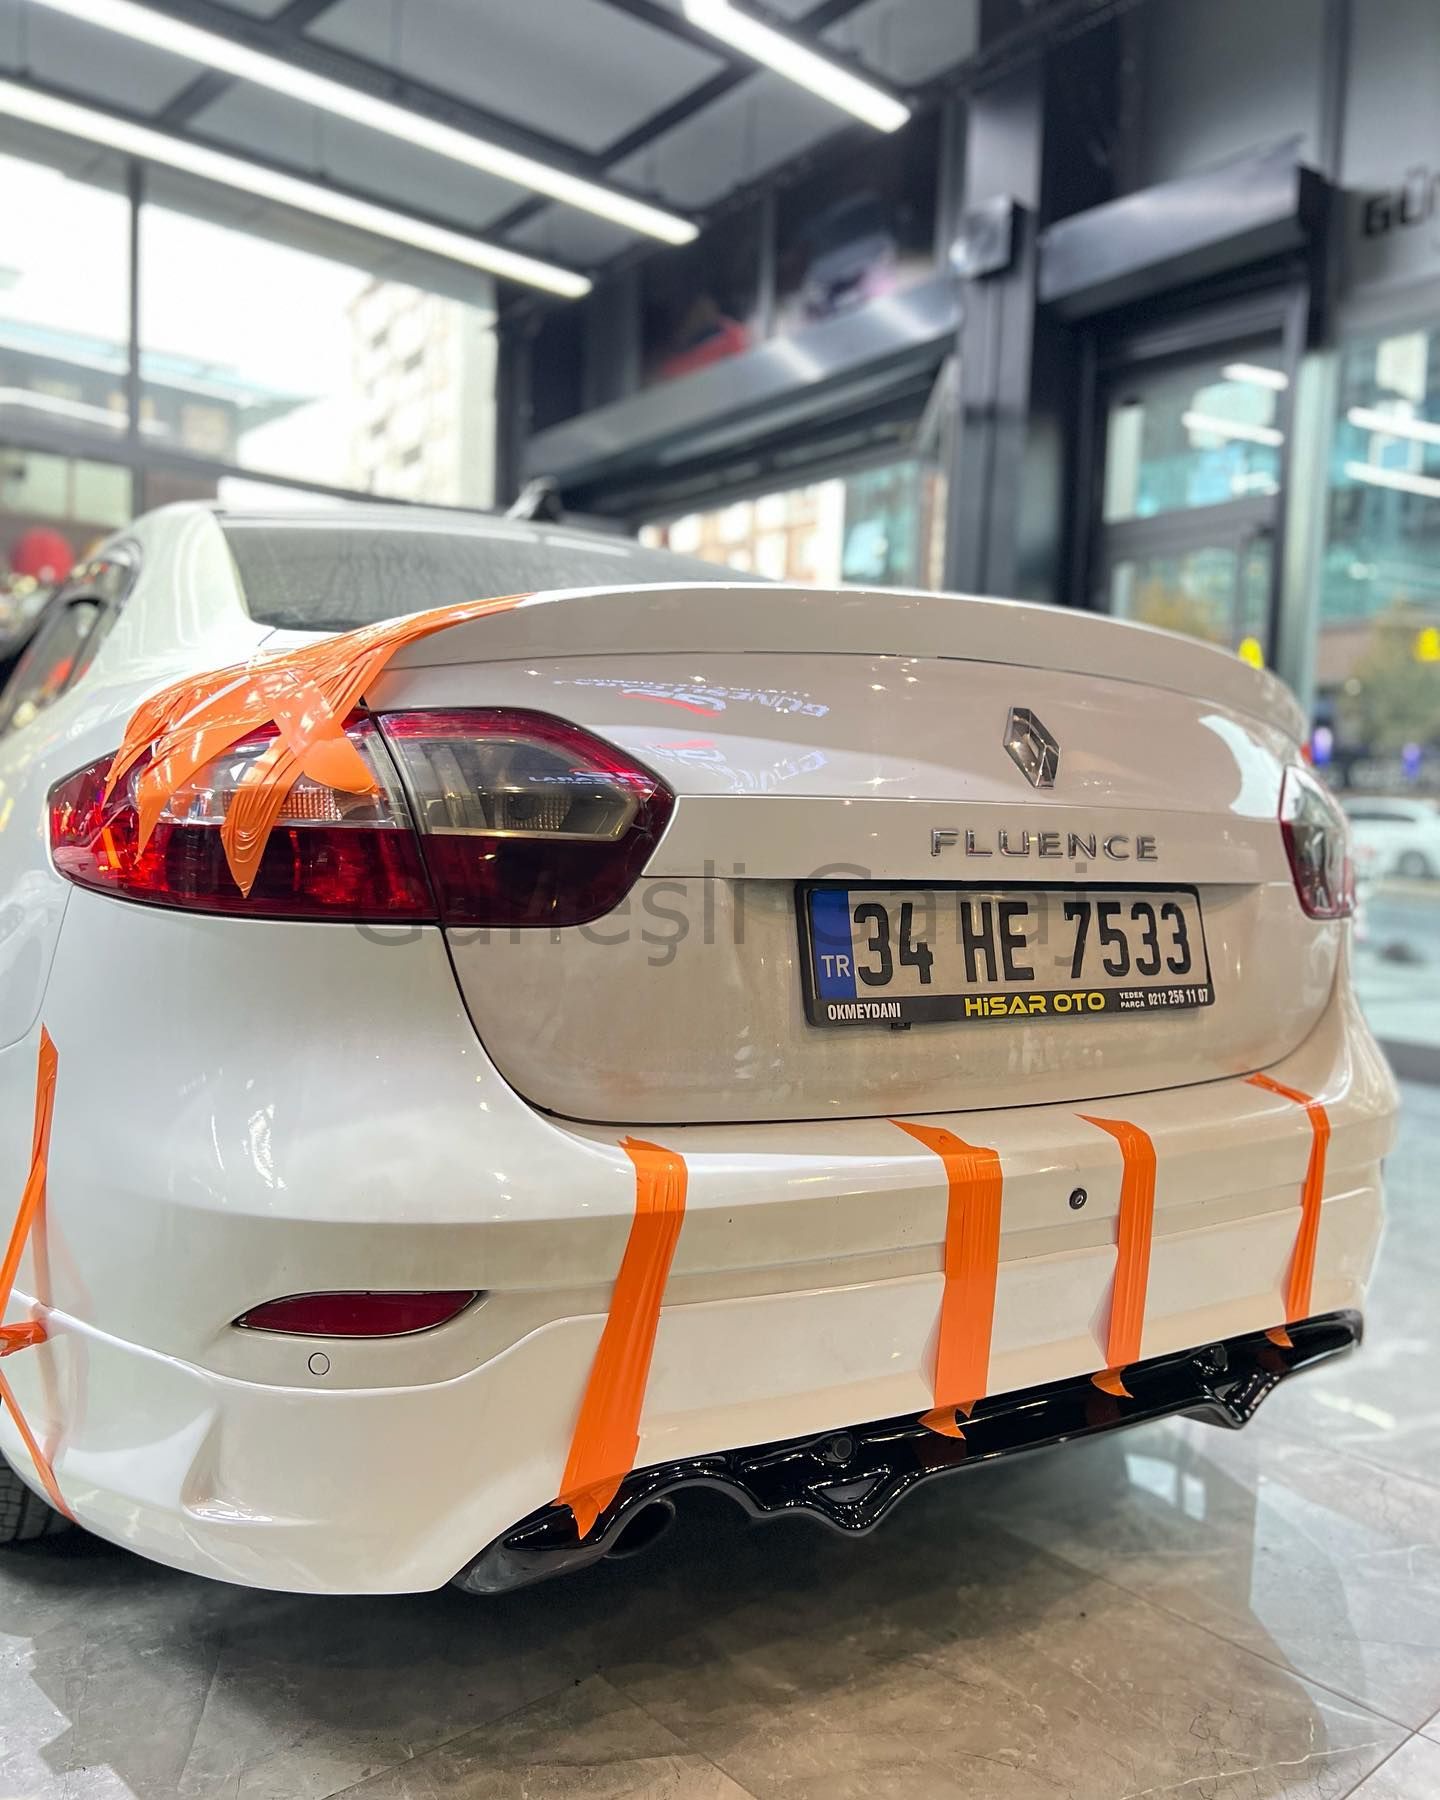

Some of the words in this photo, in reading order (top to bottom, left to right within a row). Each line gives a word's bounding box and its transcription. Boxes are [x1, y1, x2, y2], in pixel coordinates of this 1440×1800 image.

[931, 828, 1158, 861] FLUENCE
[853, 902, 934, 986] 34
[960, 901, 1035, 983] HE
[1063, 901, 1192, 979] 7533
[821, 954, 850, 978] TR
[1053, 992, 1106, 1012] OTO
[1119, 991, 1144, 999] YEDEK
[1148, 992, 1167, 1006] 0212
[1168, 989, 1184, 1004] 256
[1186, 989, 1197, 1003] 11
[1198, 988, 1209, 1003] 07
[827, 1002, 902, 1021] OKMEYDANI
